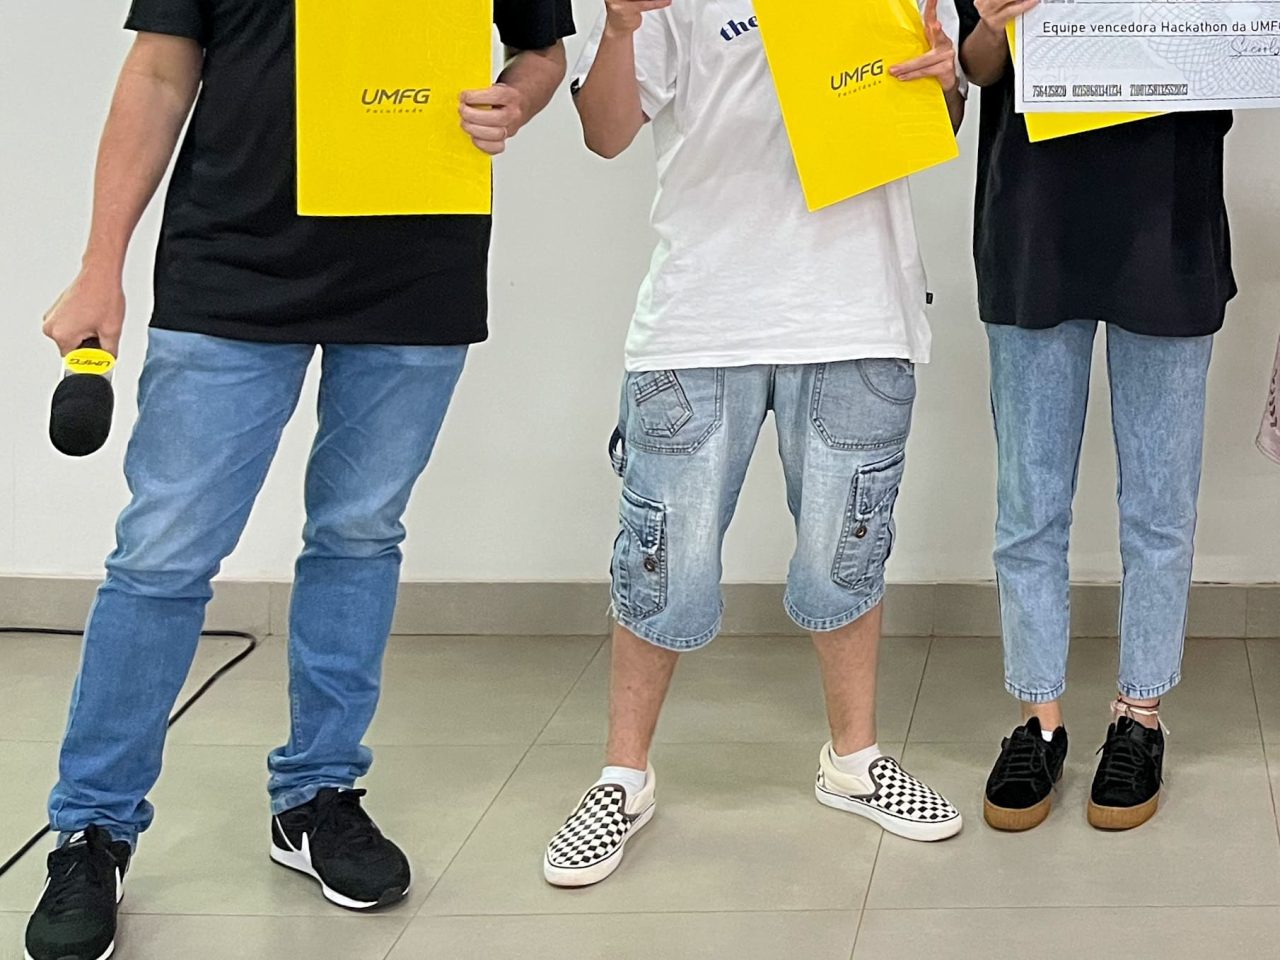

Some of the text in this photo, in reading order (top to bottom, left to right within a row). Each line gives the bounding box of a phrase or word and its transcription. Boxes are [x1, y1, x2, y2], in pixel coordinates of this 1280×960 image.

[1043, 21, 1086, 36] Equipe
[1090, 21, 1157, 33] vencedora
[1161, 22, 1228, 33] Hackathon
[1232, 21, 1246, 32] da
[830, 59, 884, 90] UMFG
[361, 88, 431, 105] UMFG
